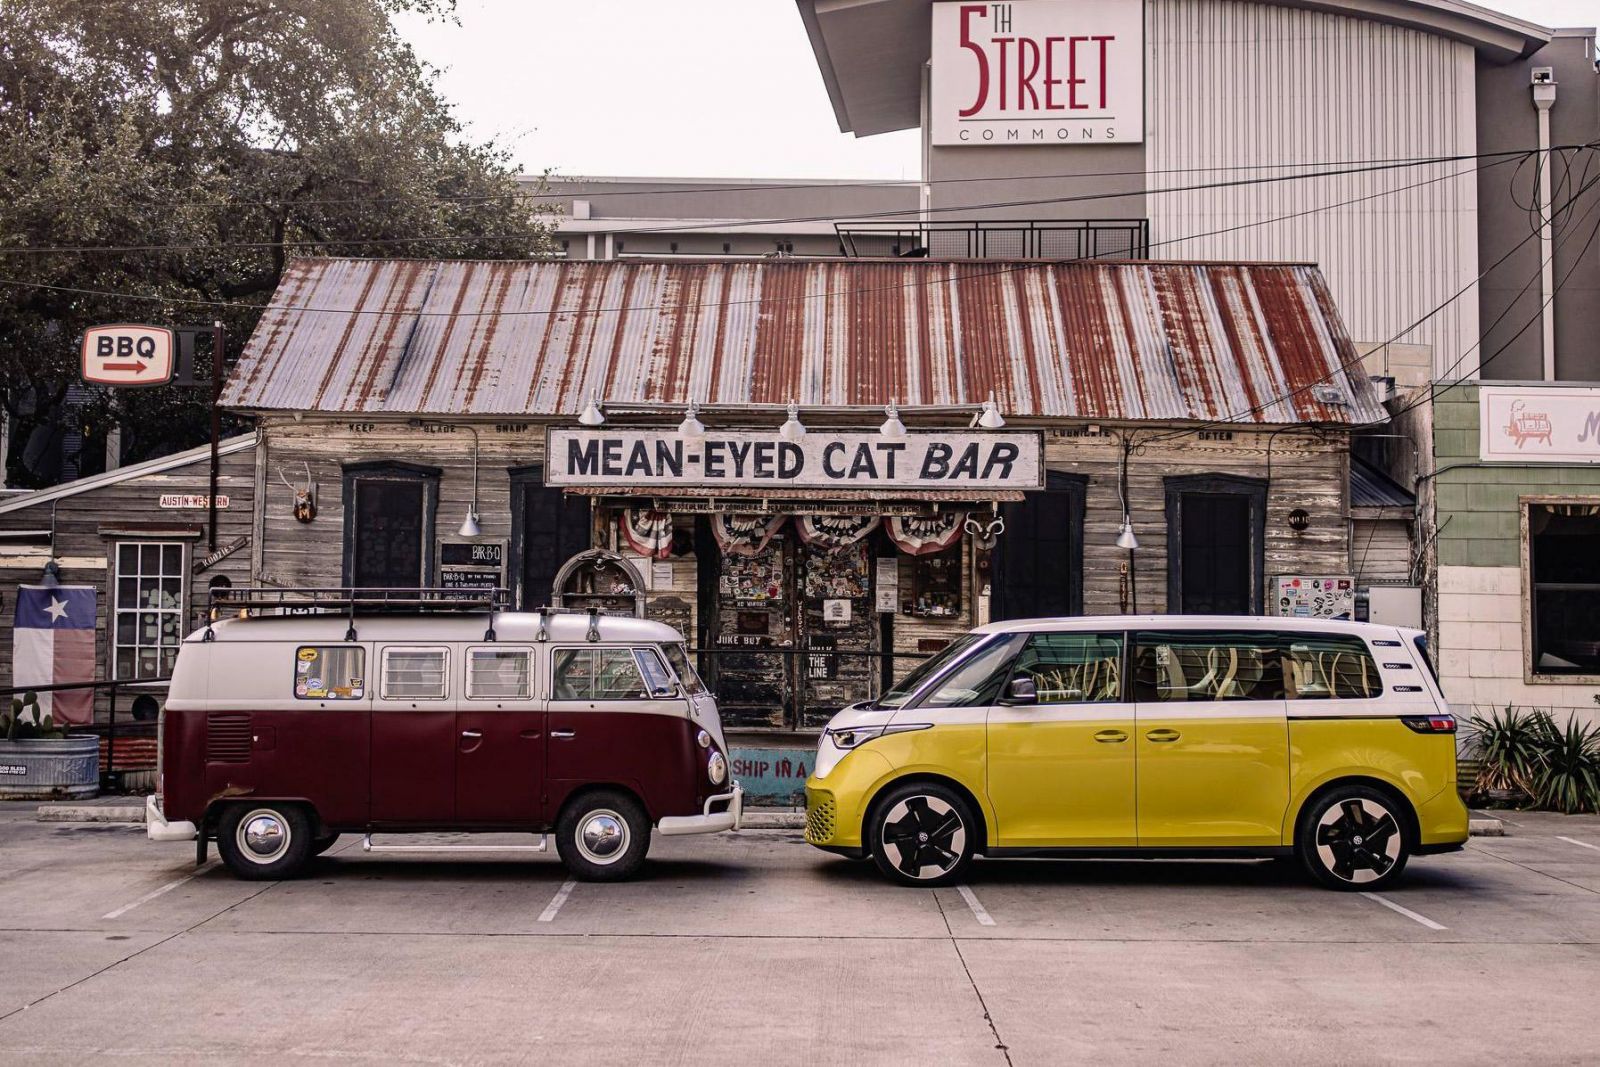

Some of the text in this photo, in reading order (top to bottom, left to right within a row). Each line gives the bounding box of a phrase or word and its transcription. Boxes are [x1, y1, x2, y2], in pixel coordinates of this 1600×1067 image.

[959, 128, 1115, 141] COMMONS
[97, 336, 155, 359] BBQ
[1199, 431, 1232, 441] OFTEN
[567, 439, 1020, 479] MEAN-EYED CAT BAR
[161, 496, 228, 506] AUSTIN-WESRN
[808, 657, 826, 667] THE
[808, 668, 828, 678] LINE
[729, 759, 769, 779] SHIP
